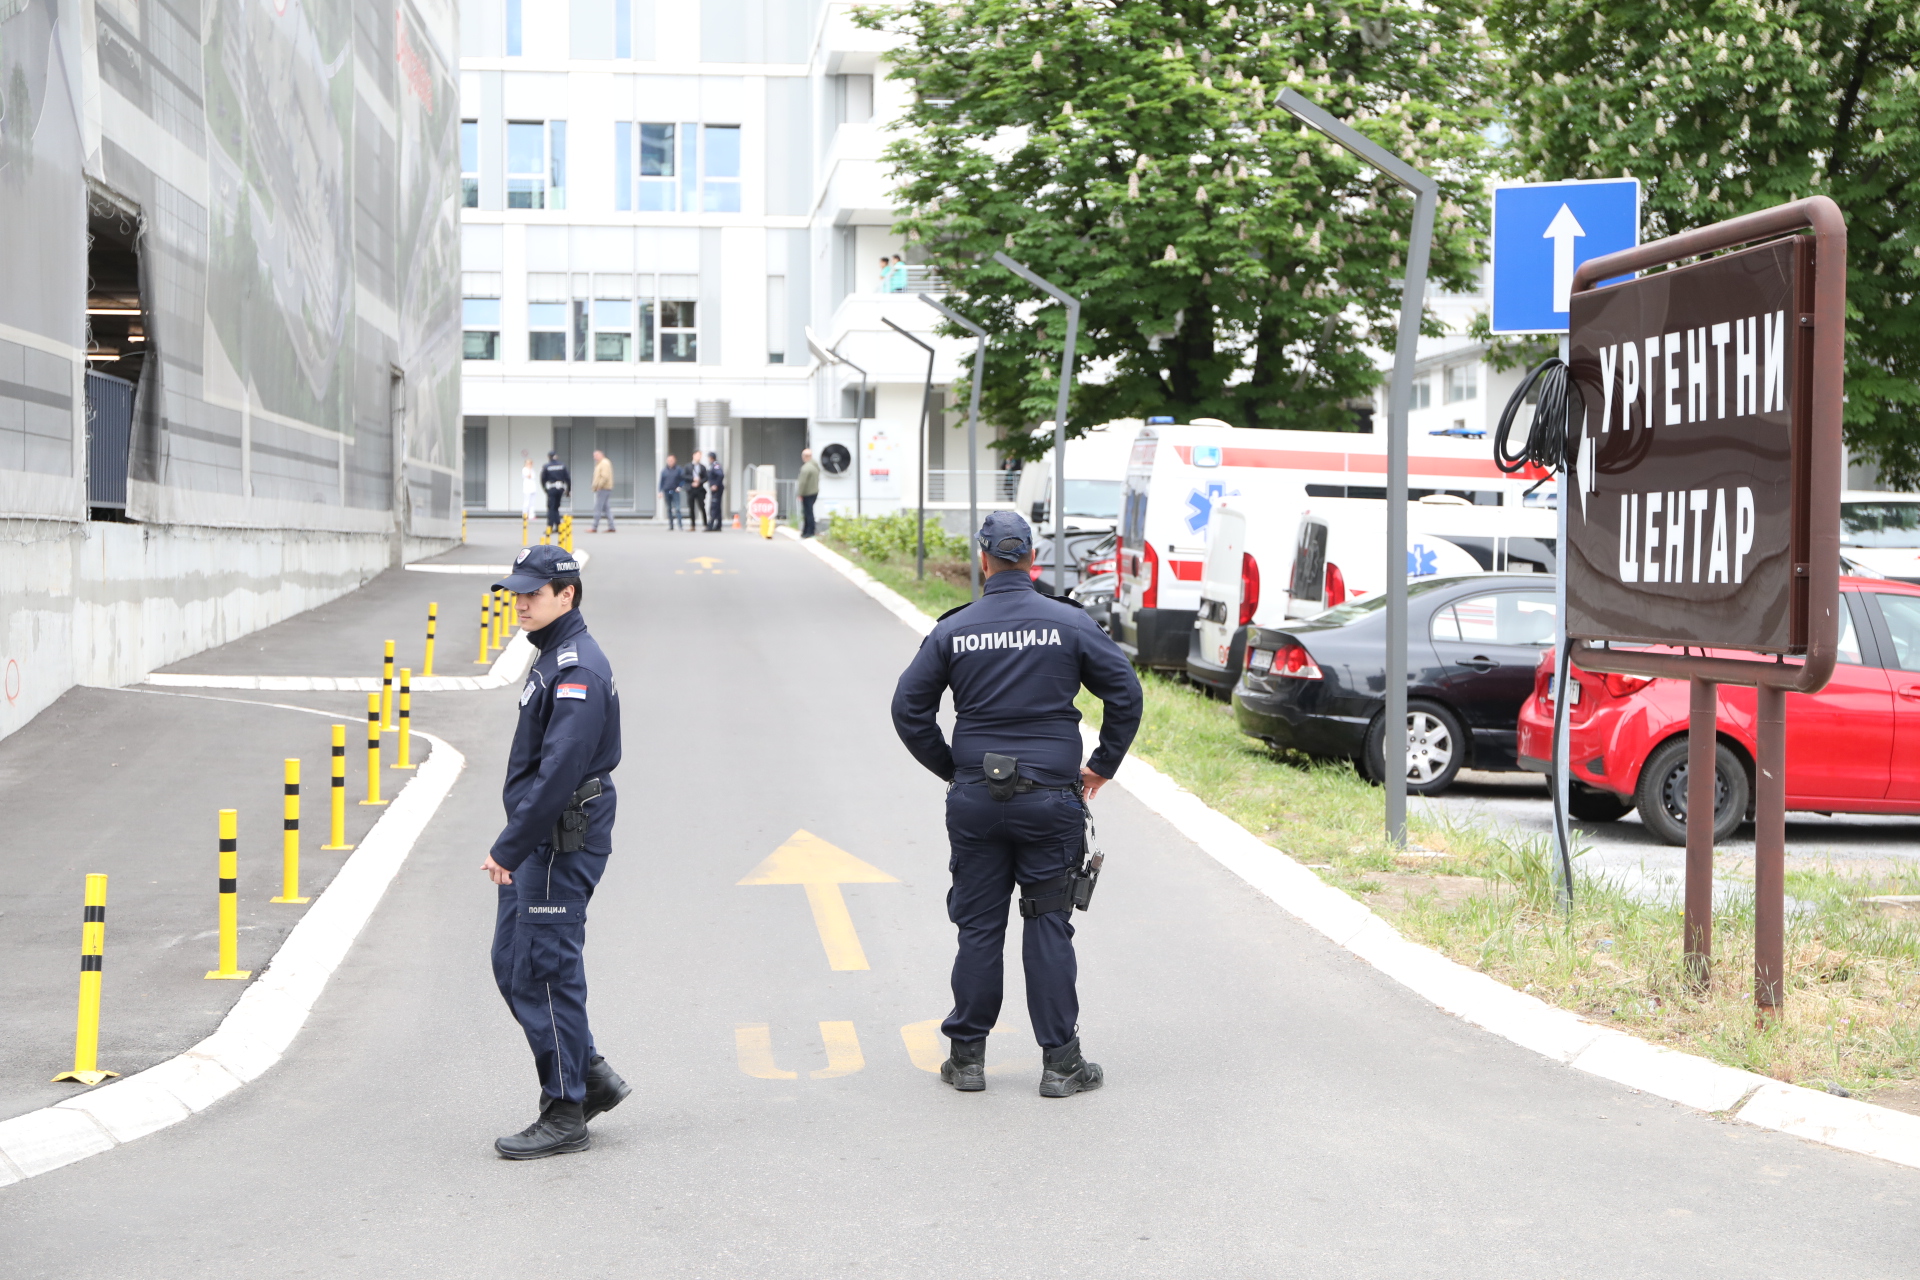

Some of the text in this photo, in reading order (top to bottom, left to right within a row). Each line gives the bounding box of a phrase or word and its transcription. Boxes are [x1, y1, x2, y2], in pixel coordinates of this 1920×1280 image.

[1599, 310, 1785, 434] УРГЕНТНИ
[751, 502, 774, 513] STOP
[1618, 486, 1755, 584] ЦЕНТАР
[952, 629, 1062, 653] ПОЛИЦИЈА
[528, 906, 567, 914] ПОЛИЦИЈА
